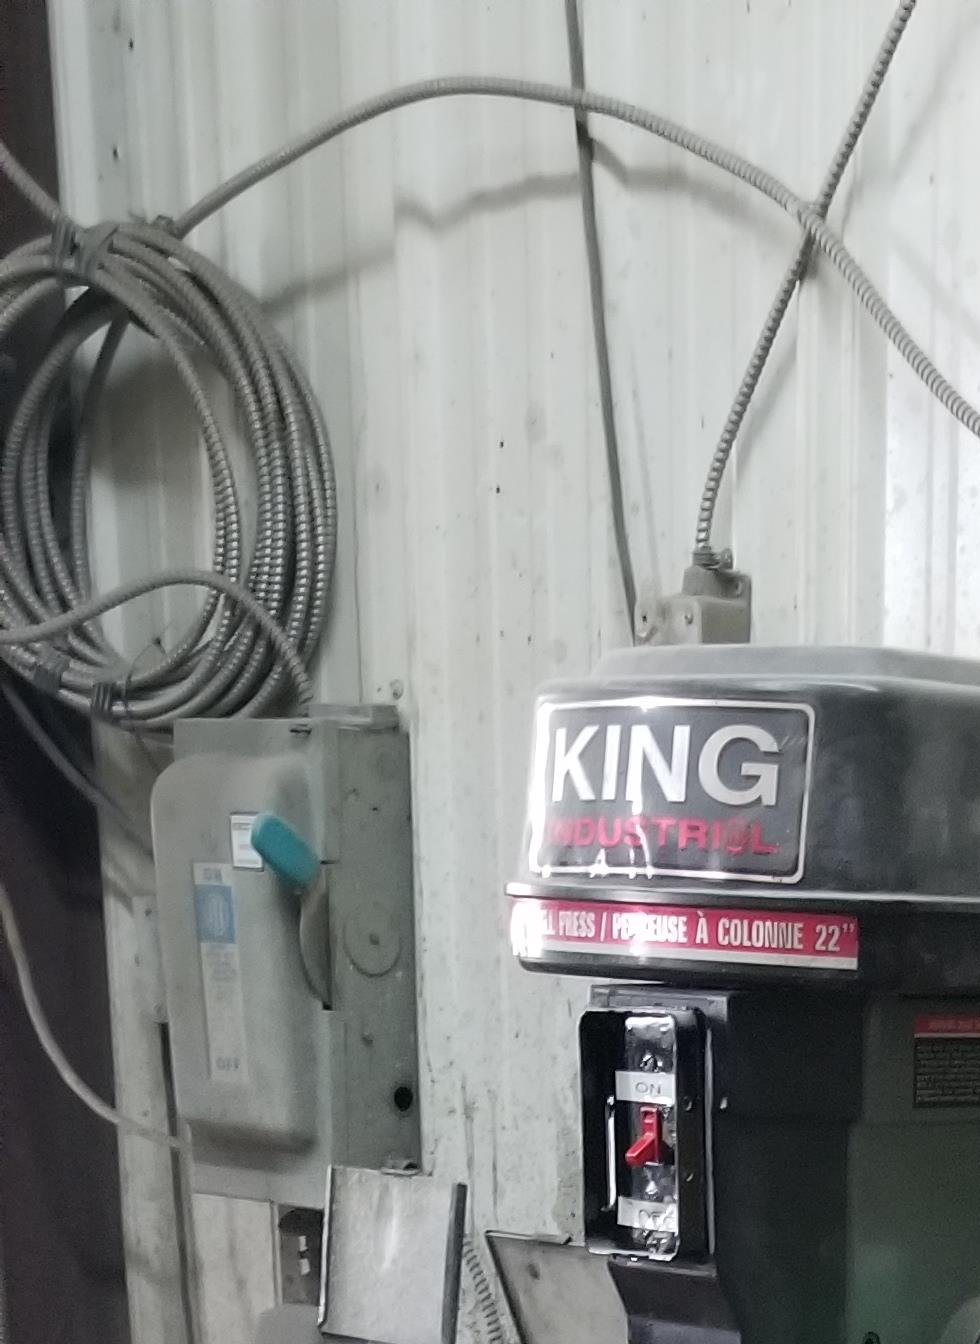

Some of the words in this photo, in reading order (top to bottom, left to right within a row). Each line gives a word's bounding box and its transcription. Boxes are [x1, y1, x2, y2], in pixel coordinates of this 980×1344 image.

[552, 724, 780, 807] KING
[695, 910, 709, 944] À
[717, 917, 804, 949] COLONNE
[635, 1081, 662, 1096] ON
